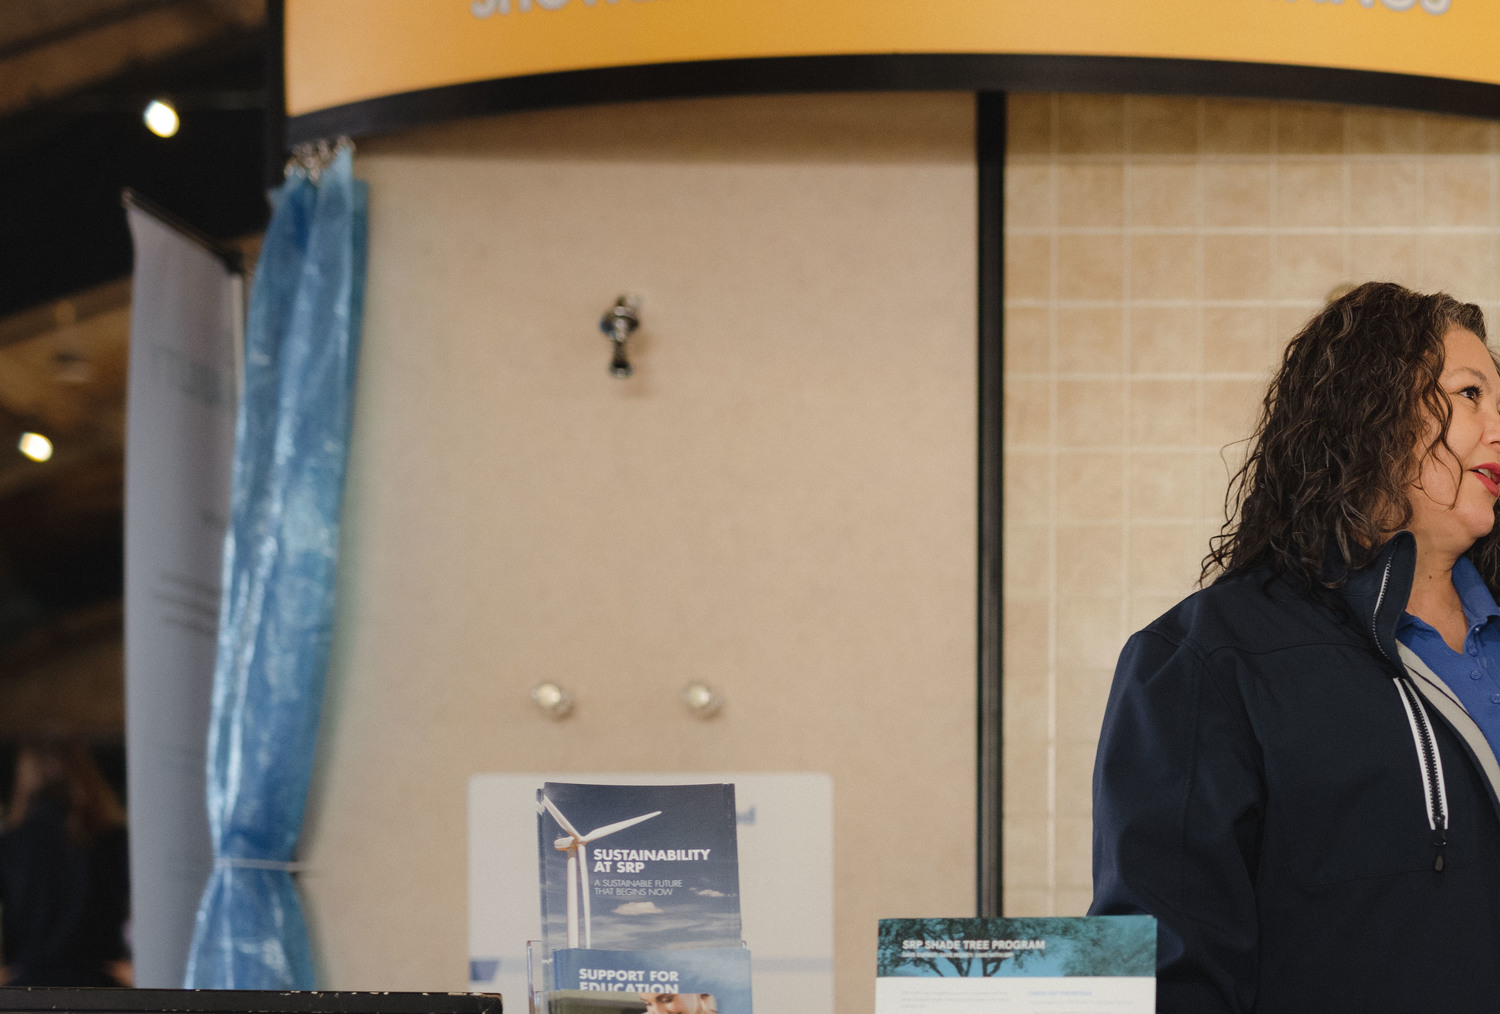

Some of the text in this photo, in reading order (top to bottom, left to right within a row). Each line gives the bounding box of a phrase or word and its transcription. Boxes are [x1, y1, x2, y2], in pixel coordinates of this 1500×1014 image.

[593, 848, 711, 861] SUSTAINABILITY
[593, 861, 645, 873] AT SRP
[602, 880, 652, 888] SUSTAINABLE
[655, 880, 683, 888] FUTURE
[616, 888, 646, 896] BEGINS
[648, 888, 673, 896] NOW
[902, 940, 1046, 950] SRP SHADE TREE PROGRAM
[579, 968, 680, 982] SUPPORT FOR
[579, 982, 679, 994] EDUCATION
